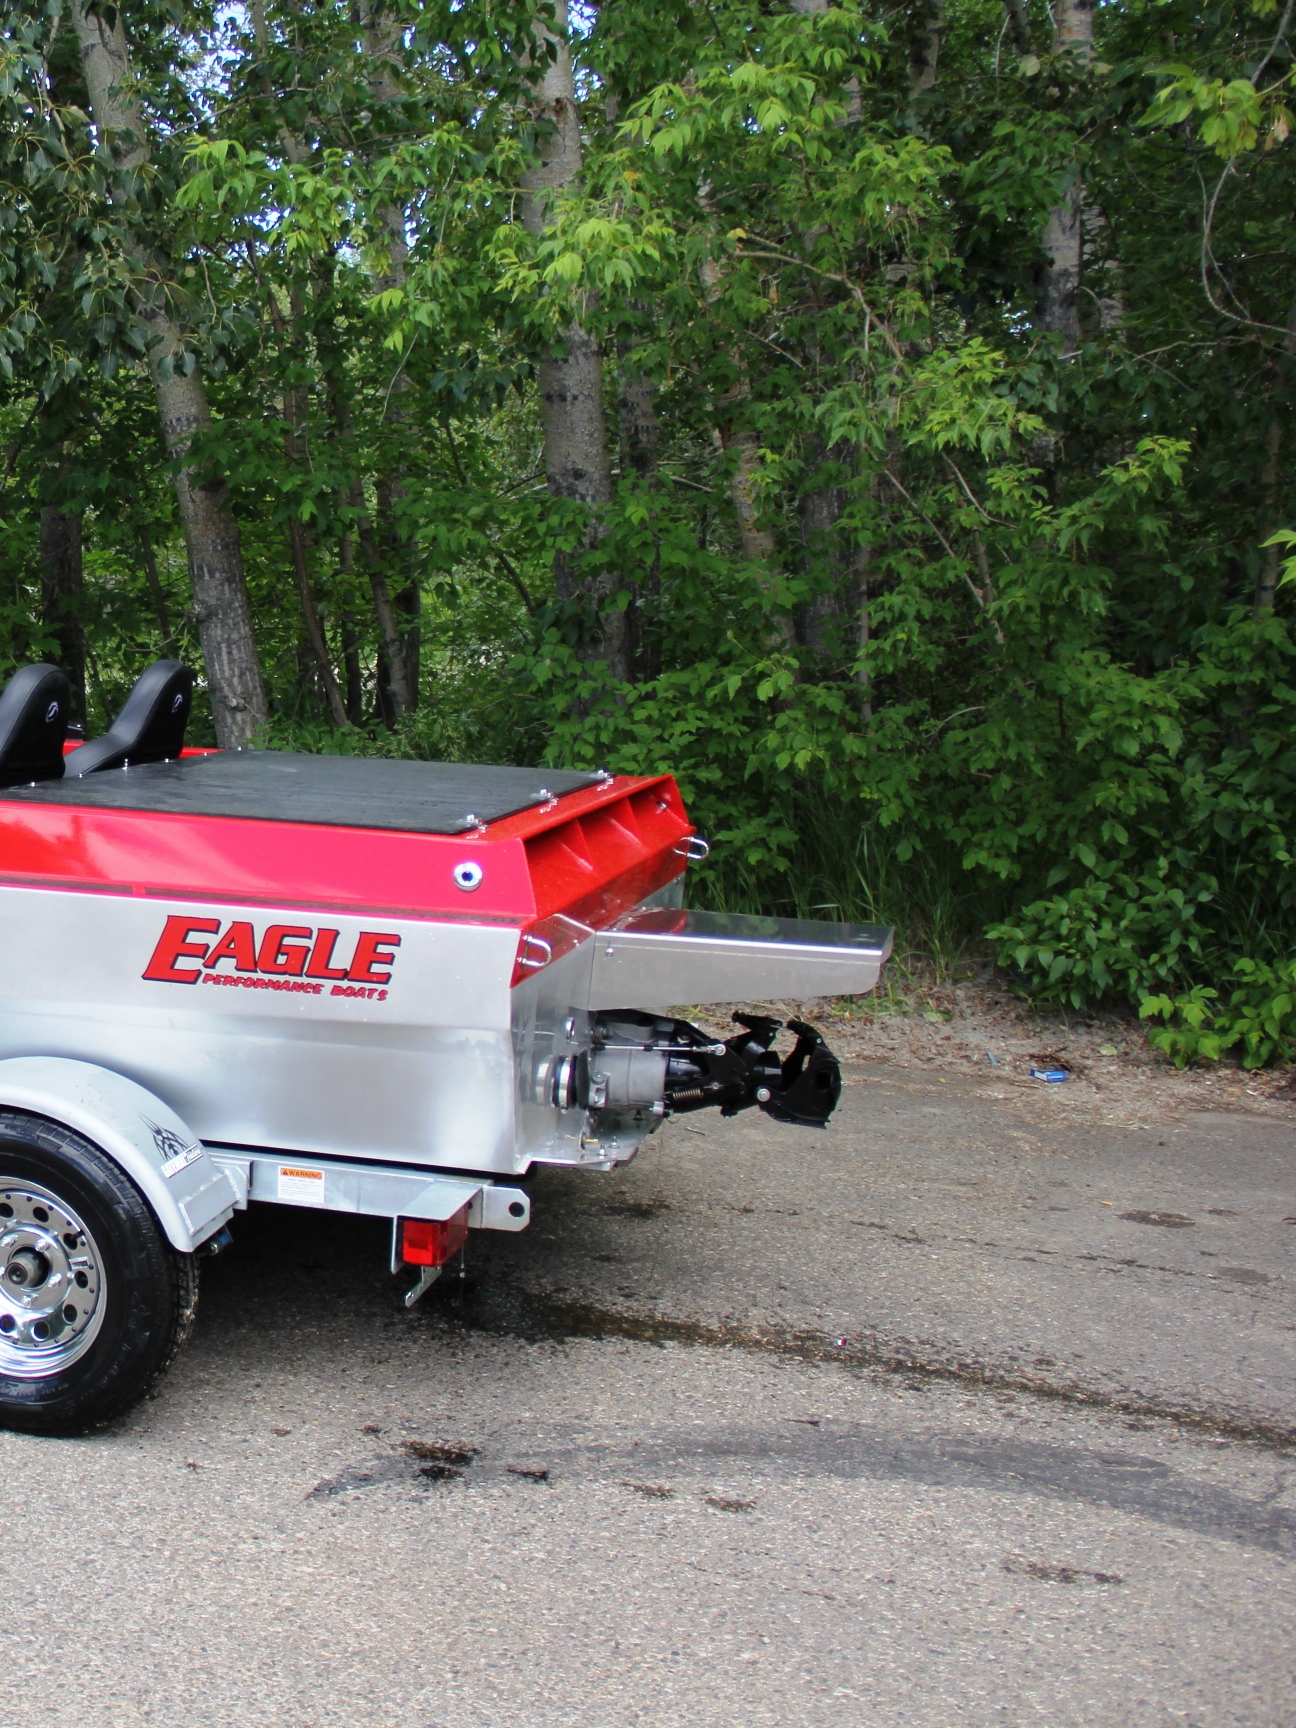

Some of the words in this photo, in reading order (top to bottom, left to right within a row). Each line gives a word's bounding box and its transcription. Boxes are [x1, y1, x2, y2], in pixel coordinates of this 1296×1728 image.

[142, 915, 402, 985] EAGLE
[202, 973, 325, 995] PERFORMANCE
[330, 985, 389, 1001] BOATS
[289, 1170, 322, 1180] WARNING
